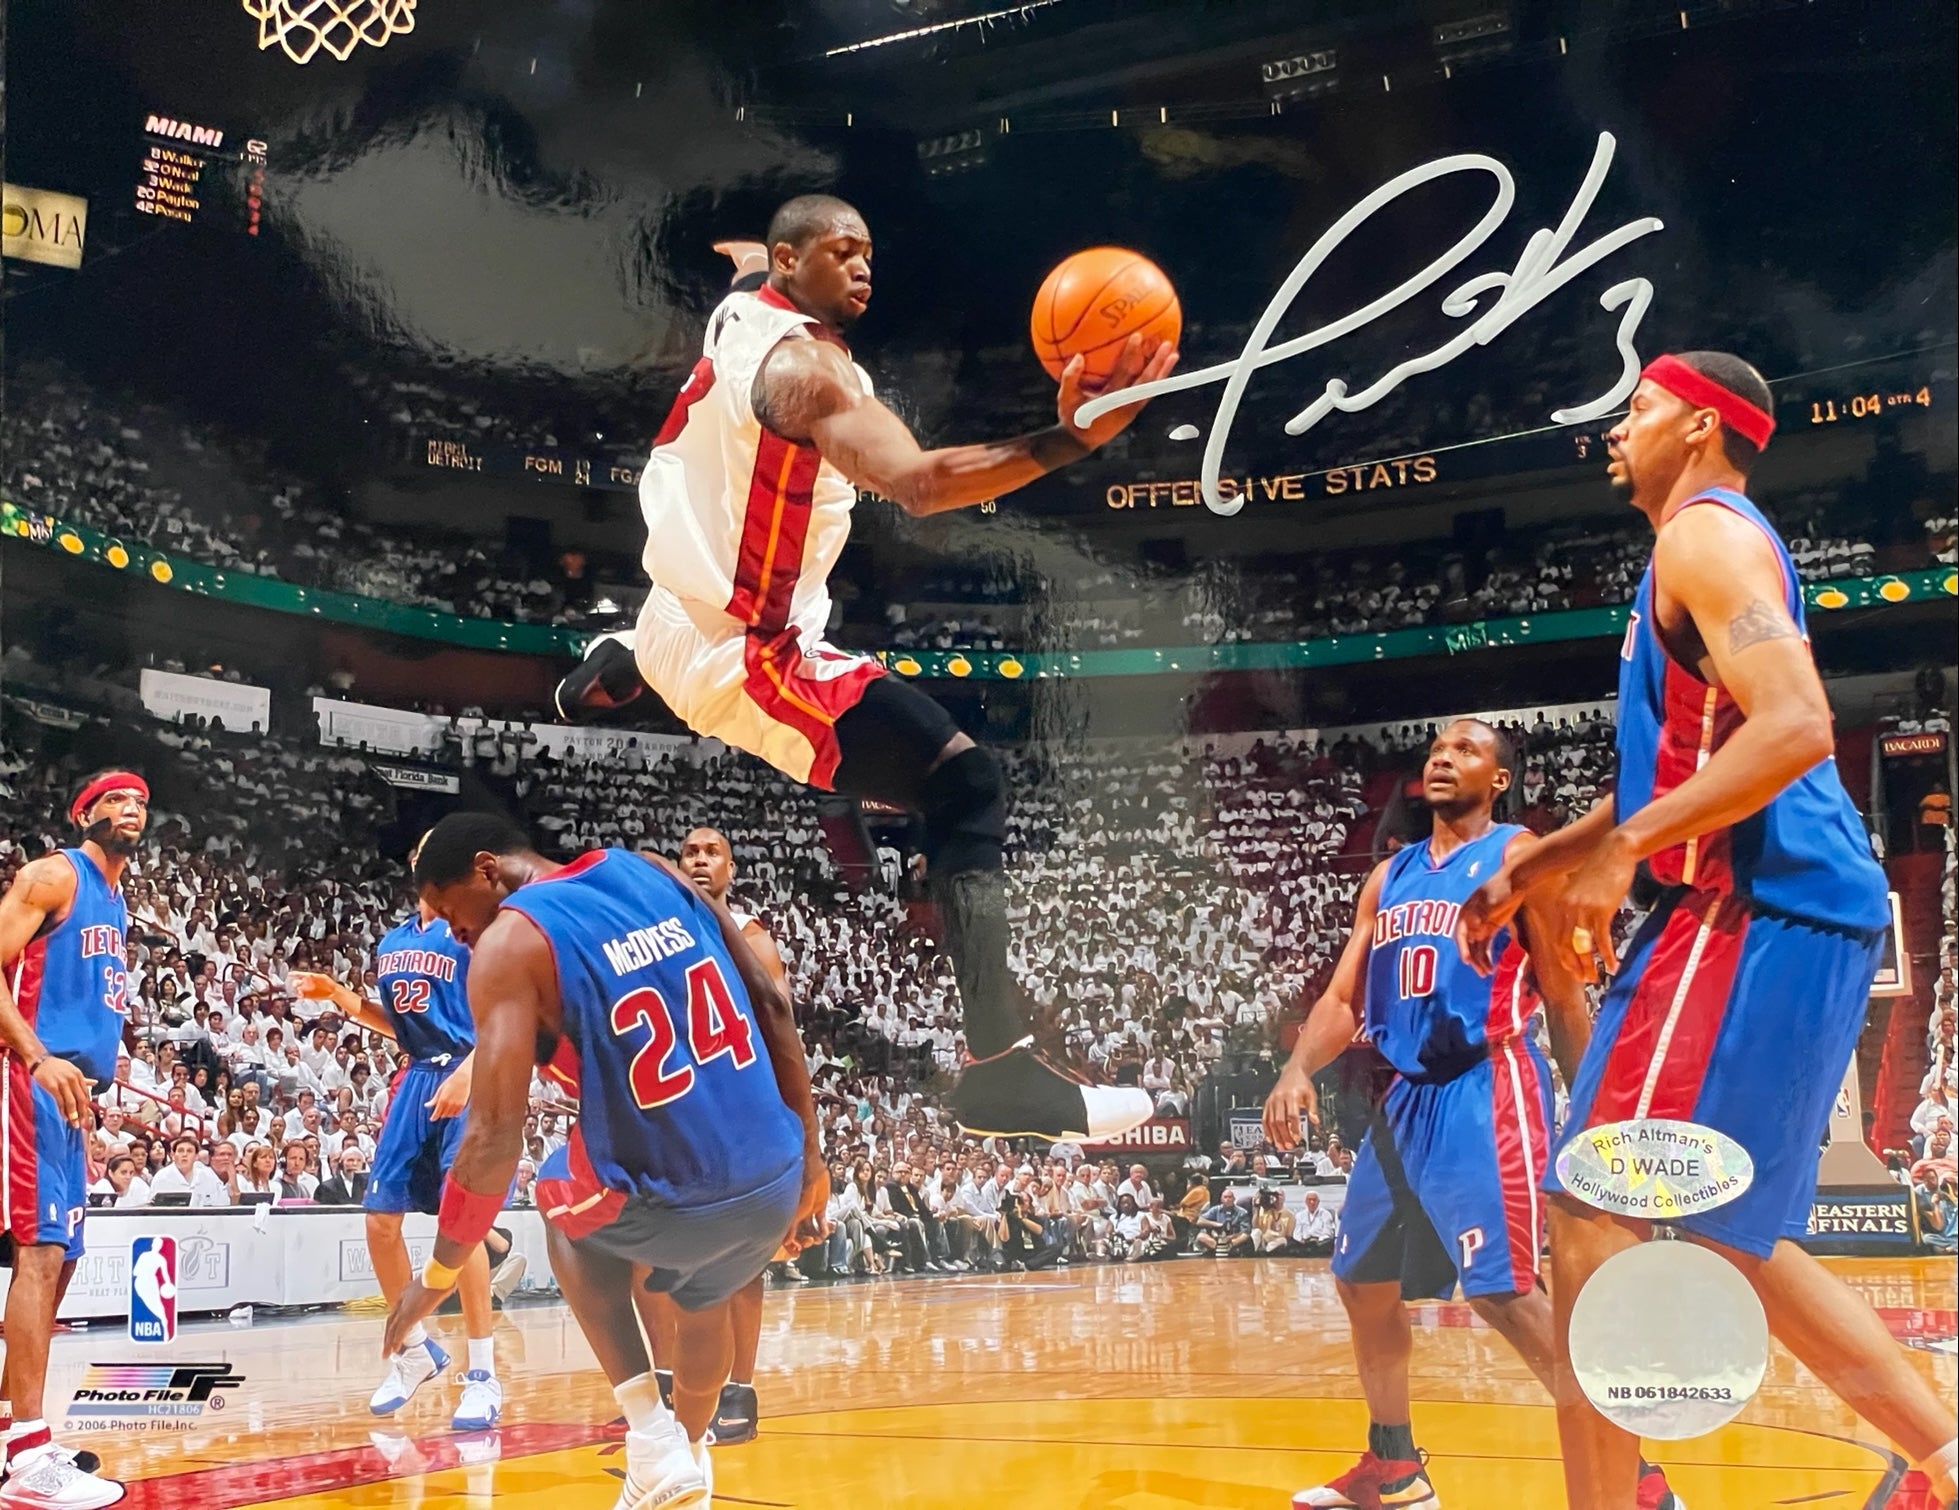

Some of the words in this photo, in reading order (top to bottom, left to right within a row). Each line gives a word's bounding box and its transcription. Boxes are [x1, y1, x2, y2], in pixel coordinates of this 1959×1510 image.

[145, 115, 224, 148] MIAMI
[161, 149, 206, 168] Walker
[137, 185, 156, 200] 20
[157, 190, 200, 210] Payton
[1915, 386, 1931, 407] 4
[428, 453, 483, 471] DETROIT
[525, 456, 563, 475] FGM
[1325, 456, 1437, 494] STATS
[1884, 737, 1940, 753] BACARDI
[1373, 900, 1462, 950] DETROI
[602, 917, 696, 977] McDYESS
[378, 949, 457, 983] DETROIT
[1400, 945, 1437, 1000] 10
[392, 979, 431, 1014] 22
[611, 956, 757, 1110] 24
[1593, 1132, 1632, 1153] Rich
[1638, 1128, 1713, 1154] Altman's
[1611, 1158, 1625, 1175] D
[1633, 1158, 1699, 1176] WADE
[1571, 1173, 1648, 1208] Hollywood
[1653, 1174, 1739, 1208] Collectibles
[1817, 1204, 1907, 1218] EASTERN
[1818, 1219, 1908, 1234] FINALS
[135, 1321, 162, 1337] NBA
[73, 1389, 141, 1402] Photo
[143, 1389, 184, 1402] File
[1608, 1387, 1632, 1399] NB
[1634, 1386, 1732, 1400] 061842633
[148, 1404, 200, 1415] HC21806
[77, 1420, 107, 1431] 2006
[110, 1420, 147, 1431] Photo
